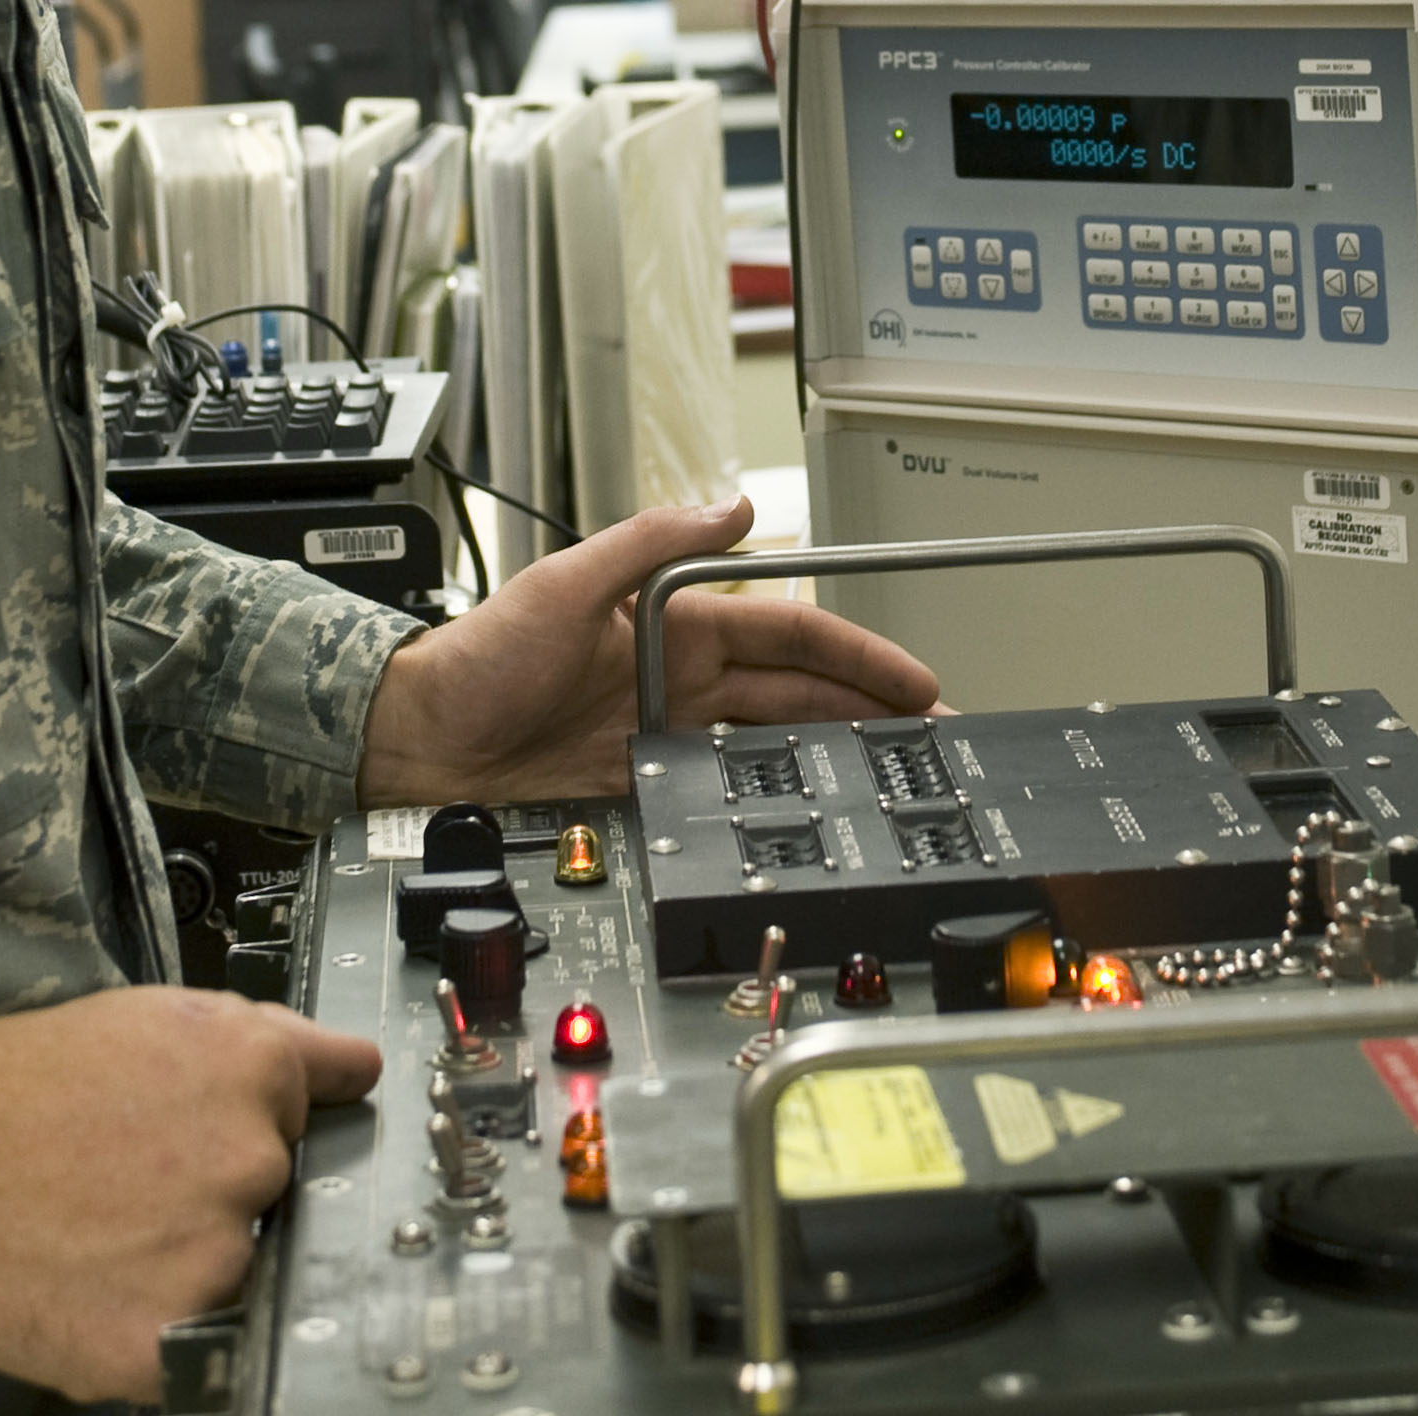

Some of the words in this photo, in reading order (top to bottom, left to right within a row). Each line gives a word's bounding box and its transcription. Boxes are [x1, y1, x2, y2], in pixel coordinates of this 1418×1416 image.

[879, 51, 938, 70] PPC3
[953, 59, 994, 70] Pressure
[970, 103, 1095, 132] -0.00009
[1162, 142, 1197, 169] DC
[1135, 241, 1161, 250] RANGE
[1231, 245, 1254, 254] MODE
[902, 454, 947, 474] DVU
[985, 468, 1018, 480] Volume
[1336, 512, 1353, 522] NO
[1308, 519, 1382, 535] CALIBRATION
[1318, 530, 1374, 545] REQUIRED
[1325, 543, 1347, 553] FORM
[1062, 729, 1104, 769] ALTITUDE
